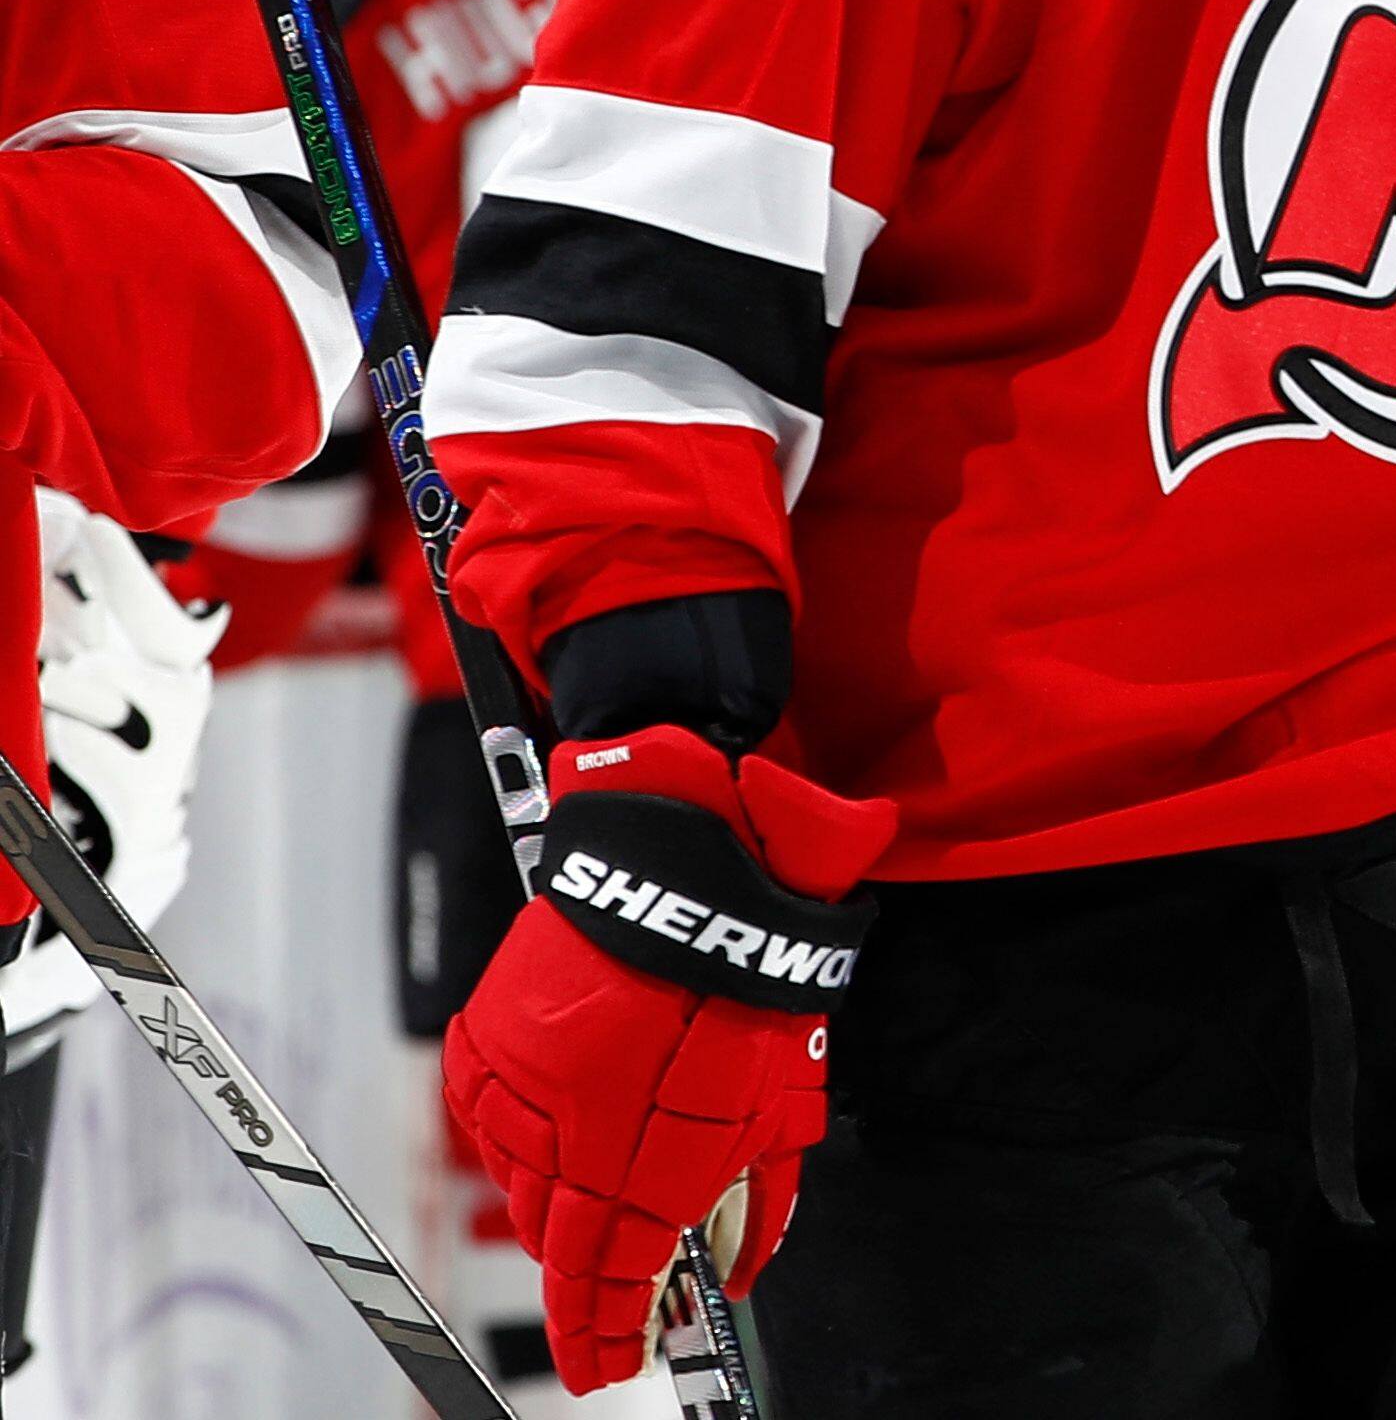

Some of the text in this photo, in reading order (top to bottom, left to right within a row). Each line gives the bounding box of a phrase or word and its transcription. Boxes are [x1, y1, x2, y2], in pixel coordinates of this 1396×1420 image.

[276, 12, 308, 72] PRO
[575, 745, 631, 771] BROWN
[139, 995, 274, 1148] XF PRO
